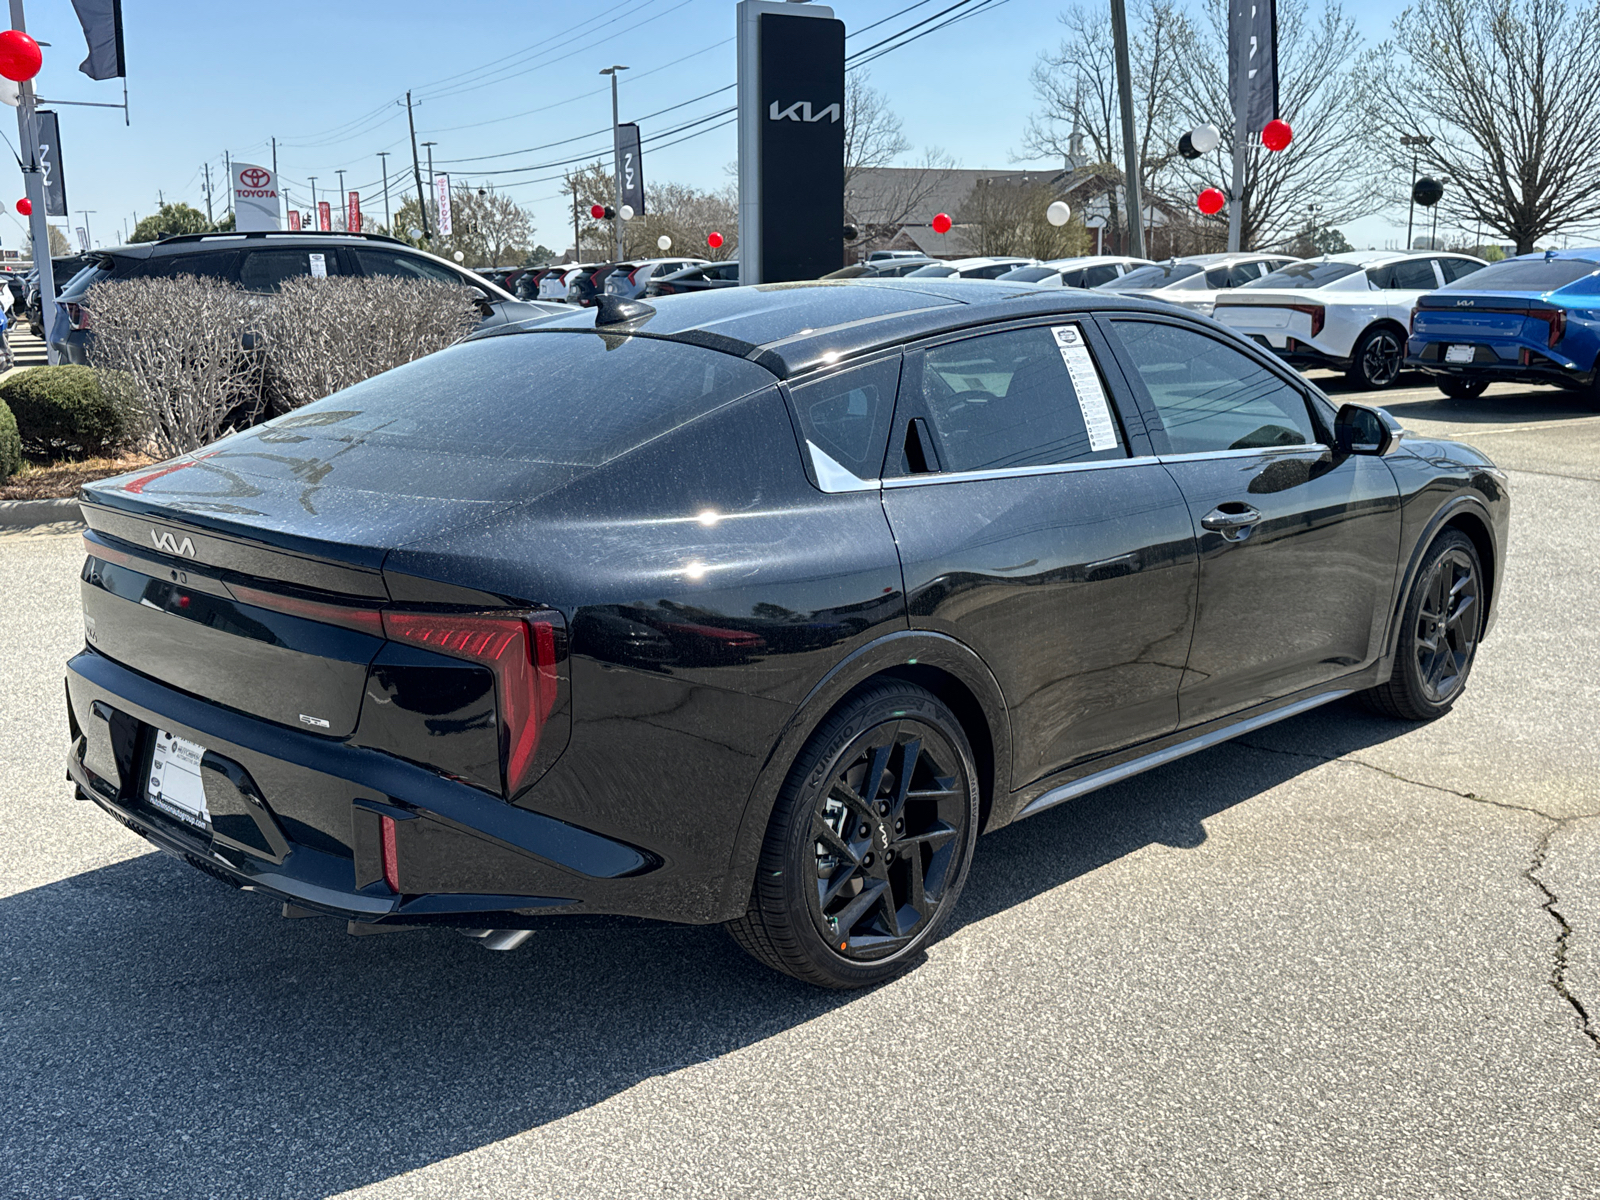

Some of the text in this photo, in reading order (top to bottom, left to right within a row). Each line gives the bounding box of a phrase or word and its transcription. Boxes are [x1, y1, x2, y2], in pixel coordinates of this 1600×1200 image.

[769, 100, 840, 123] KIA
[236, 189, 277, 198] TOYOTA
[440, 187, 449, 231] TOYOTA
[150, 528, 196, 558] KIA
[808, 725, 854, 790] KUMHO
